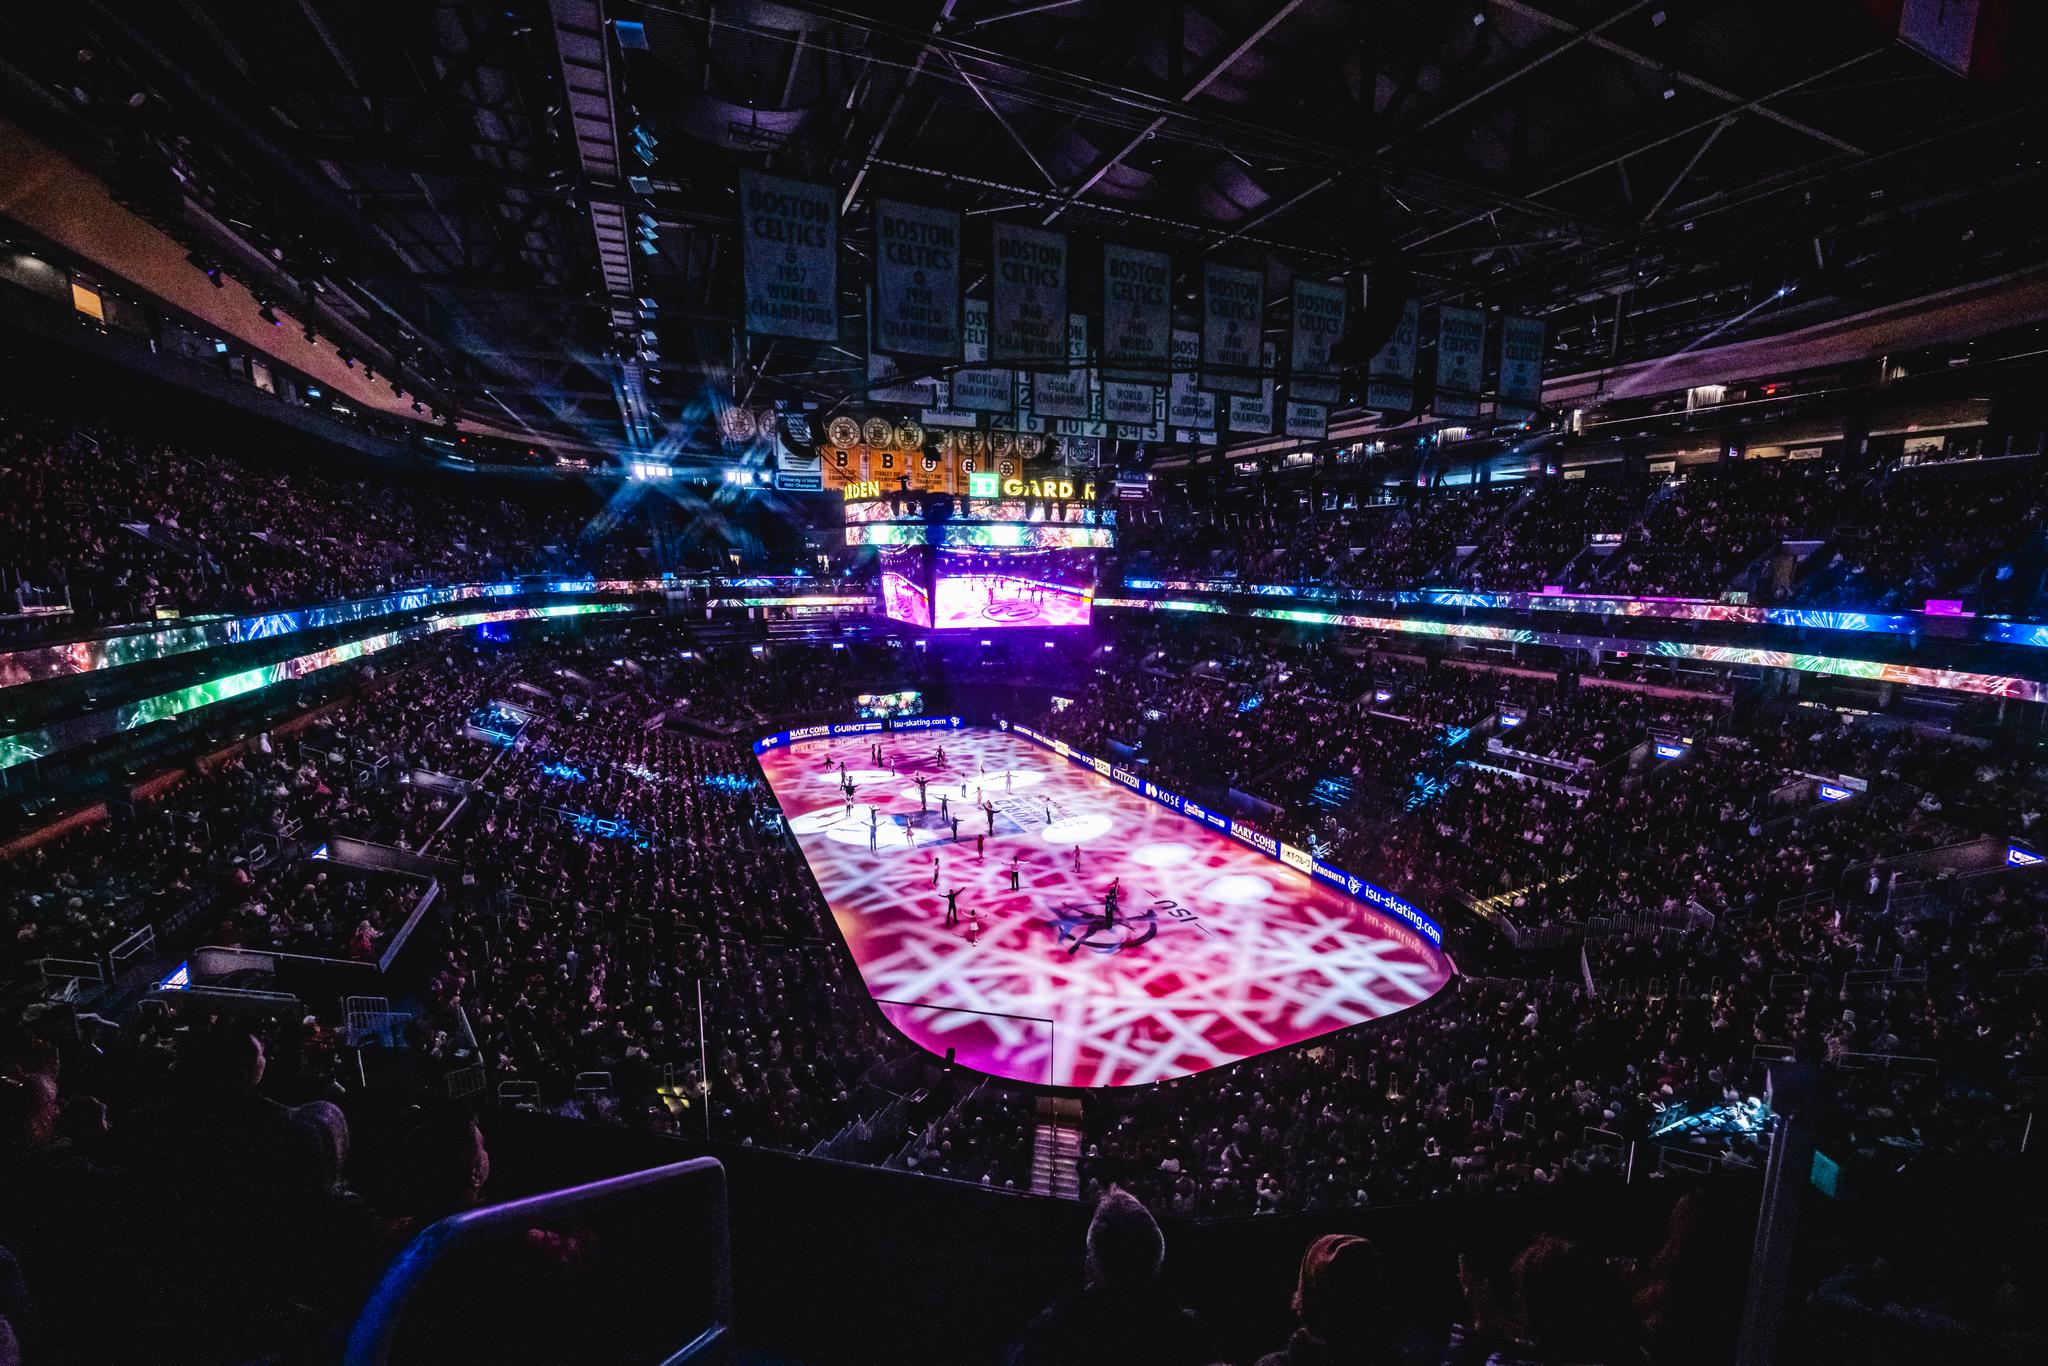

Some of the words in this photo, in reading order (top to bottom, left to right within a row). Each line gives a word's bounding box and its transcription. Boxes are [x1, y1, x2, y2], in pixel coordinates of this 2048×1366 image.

[751, 189, 829, 224] BOSTON
[753, 219, 826, 249] CELTICS
[883, 215, 954, 247] BOSTON
[887, 241, 953, 271] CELTICS
[999, 238, 1061, 266] BOSTON
[776, 265, 806, 283] 1957
[1002, 262, 1058, 289] CELTICS
[1110, 257, 1166, 286] BOSTON
[767, 282, 816, 304] WORLD
[1112, 281, 1163, 305] CELTICS
[1208, 277, 1258, 303] BOSTON
[1211, 300, 1256, 321] CELTICS
[1297, 293, 1342, 314] BOSTON
[751, 300, 832, 325] CHAMPIONS
[898, 303, 942, 324] WORLD
[883, 320, 957, 344] CHAMPIONS
[1011, 318, 1049, 338] WORLD
[1298, 313, 1339, 334] CELTICS
[1443, 319, 1482, 335] BOSTON
[998, 334, 1064, 353] CHAMPIONS
[1119, 335, 1154, 351] WORLD
[1443, 338, 1480, 353] CELTICS
[1217, 349, 1249, 365] WORLD
[967, 372, 999, 386] WORLD
[1046, 380, 1076, 394] WORLD
[957, 384, 1009, 401] CHAMPIONS
[1037, 393, 1085, 407] CHAMPIONS
[1116, 388, 1143, 402] WORLD
[1181, 395, 1205, 407] WORLD
[1107, 400, 1151, 414] CHAMPIONS
[1171, 404, 1212, 418] CHAMPIONS
[1239, 401, 1264, 413] WORLD
[1296, 407, 1318, 419] WORLD
[992, 414, 1015, 427] 24
[1026, 414, 1037, 431] 6
[1232, 410, 1270, 425] CHAMPIONS
[1287, 416, 1324, 429] CHAMPIONS
[1062, 419, 1079, 434] 10
[1090, 421, 1101, 435] 2
[1119, 423, 1139, 438] 34
[1148, 424, 1158, 439] 5
[970, 477, 997, 496] TD
[1003, 478, 1096, 500] GARDN
[789, 728, 809, 738] MARY
[809, 725, 829, 734] COHR
[834, 723, 865, 733] GUINOT
[893, 718, 947, 728] isu-skating.com
[1112, 768, 1141, 790] CITIZEN
[1158, 790, 1180, 808] KOSÉ
[1231, 821, 1254, 840] MARY
[1253, 833, 1277, 852] COHR
[1312, 861, 1346, 886] KINOSHITA
[1365, 885, 1441, 945] isu-skating.com
